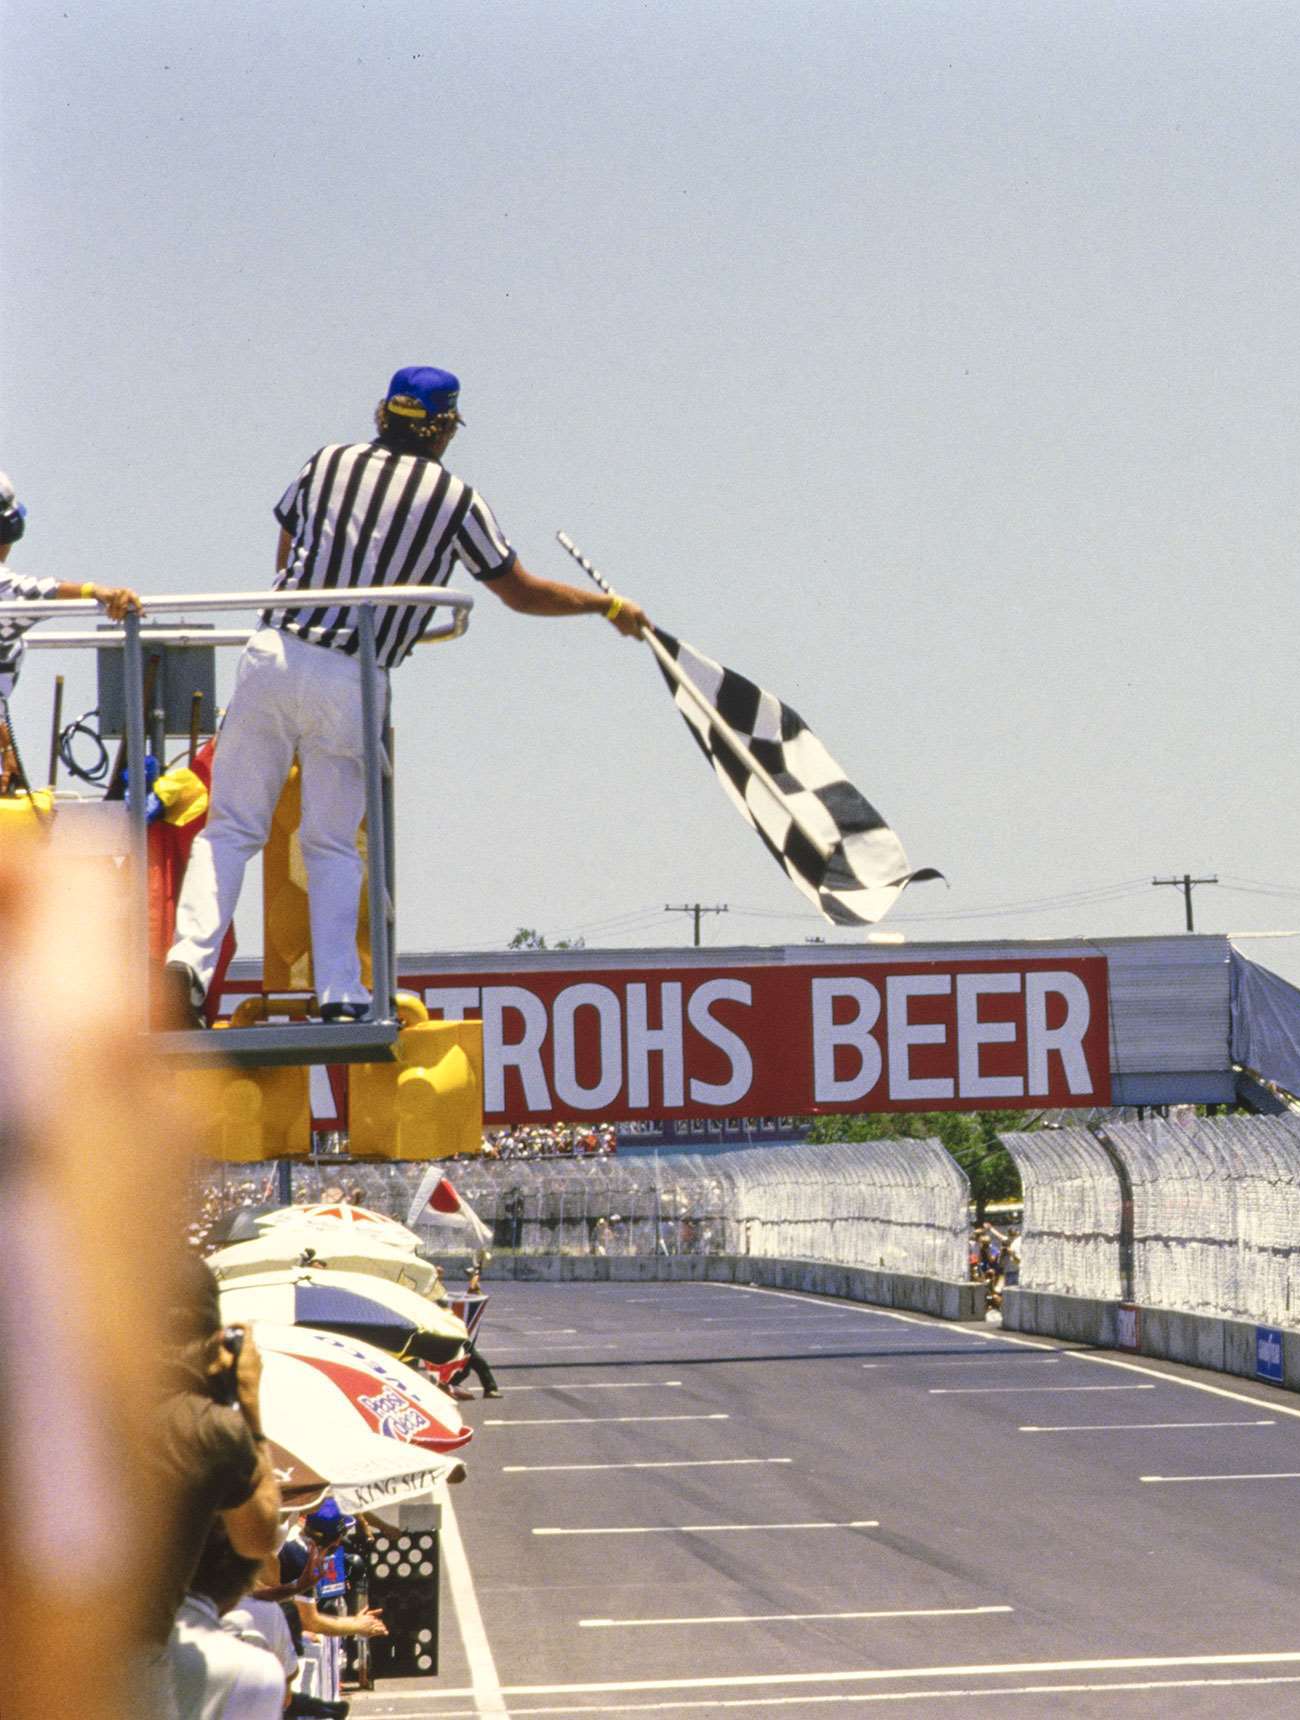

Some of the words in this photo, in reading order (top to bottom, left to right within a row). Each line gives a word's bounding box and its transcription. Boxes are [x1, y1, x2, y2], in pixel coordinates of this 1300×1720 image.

[402, 977, 753, 1113] TROHS
[811, 970, 1094, 1102] BEER
[354, 1476, 397, 1507] KING
